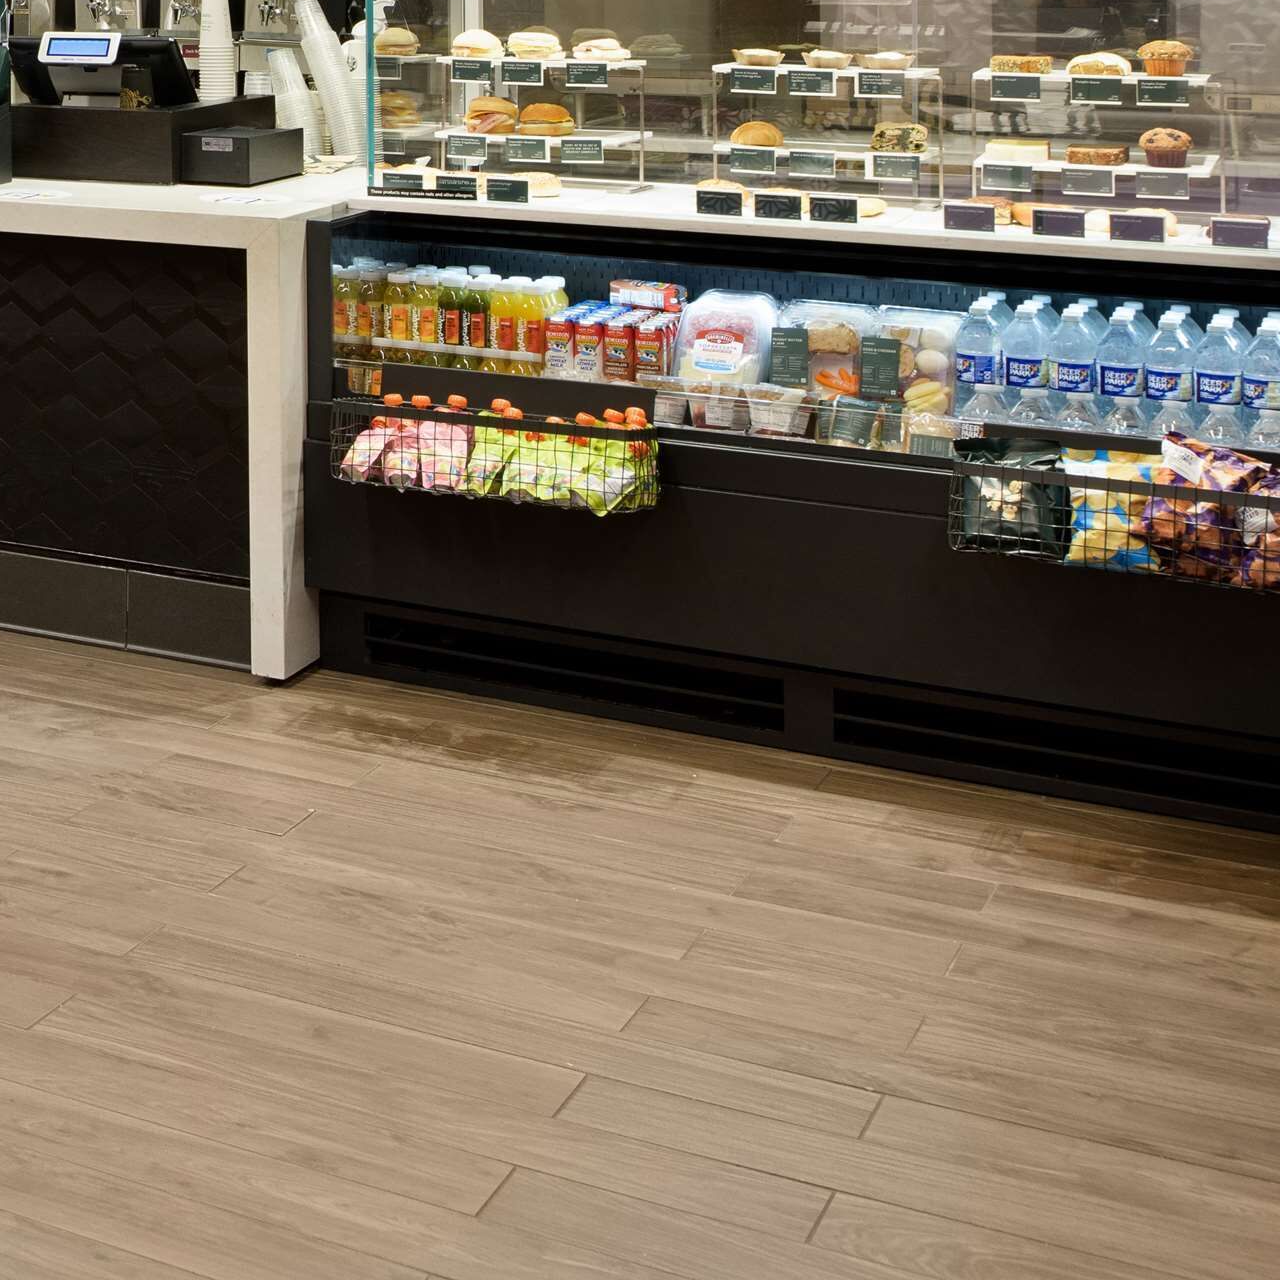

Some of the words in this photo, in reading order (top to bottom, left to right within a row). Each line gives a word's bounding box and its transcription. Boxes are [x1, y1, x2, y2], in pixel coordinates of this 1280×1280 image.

[1009, 361, 1030, 371] DEER
[1059, 366, 1080, 375] DEER
[1010, 369, 1031, 378] PARK
[1059, 374, 1081, 382] PARK
[1104, 371, 1127, 380] DEER
[1104, 378, 1127, 386] PARK
[1200, 378, 1222, 387] DEER
[1200, 385, 1225, 393] PARK
[961, 424, 980, 432] DEER
